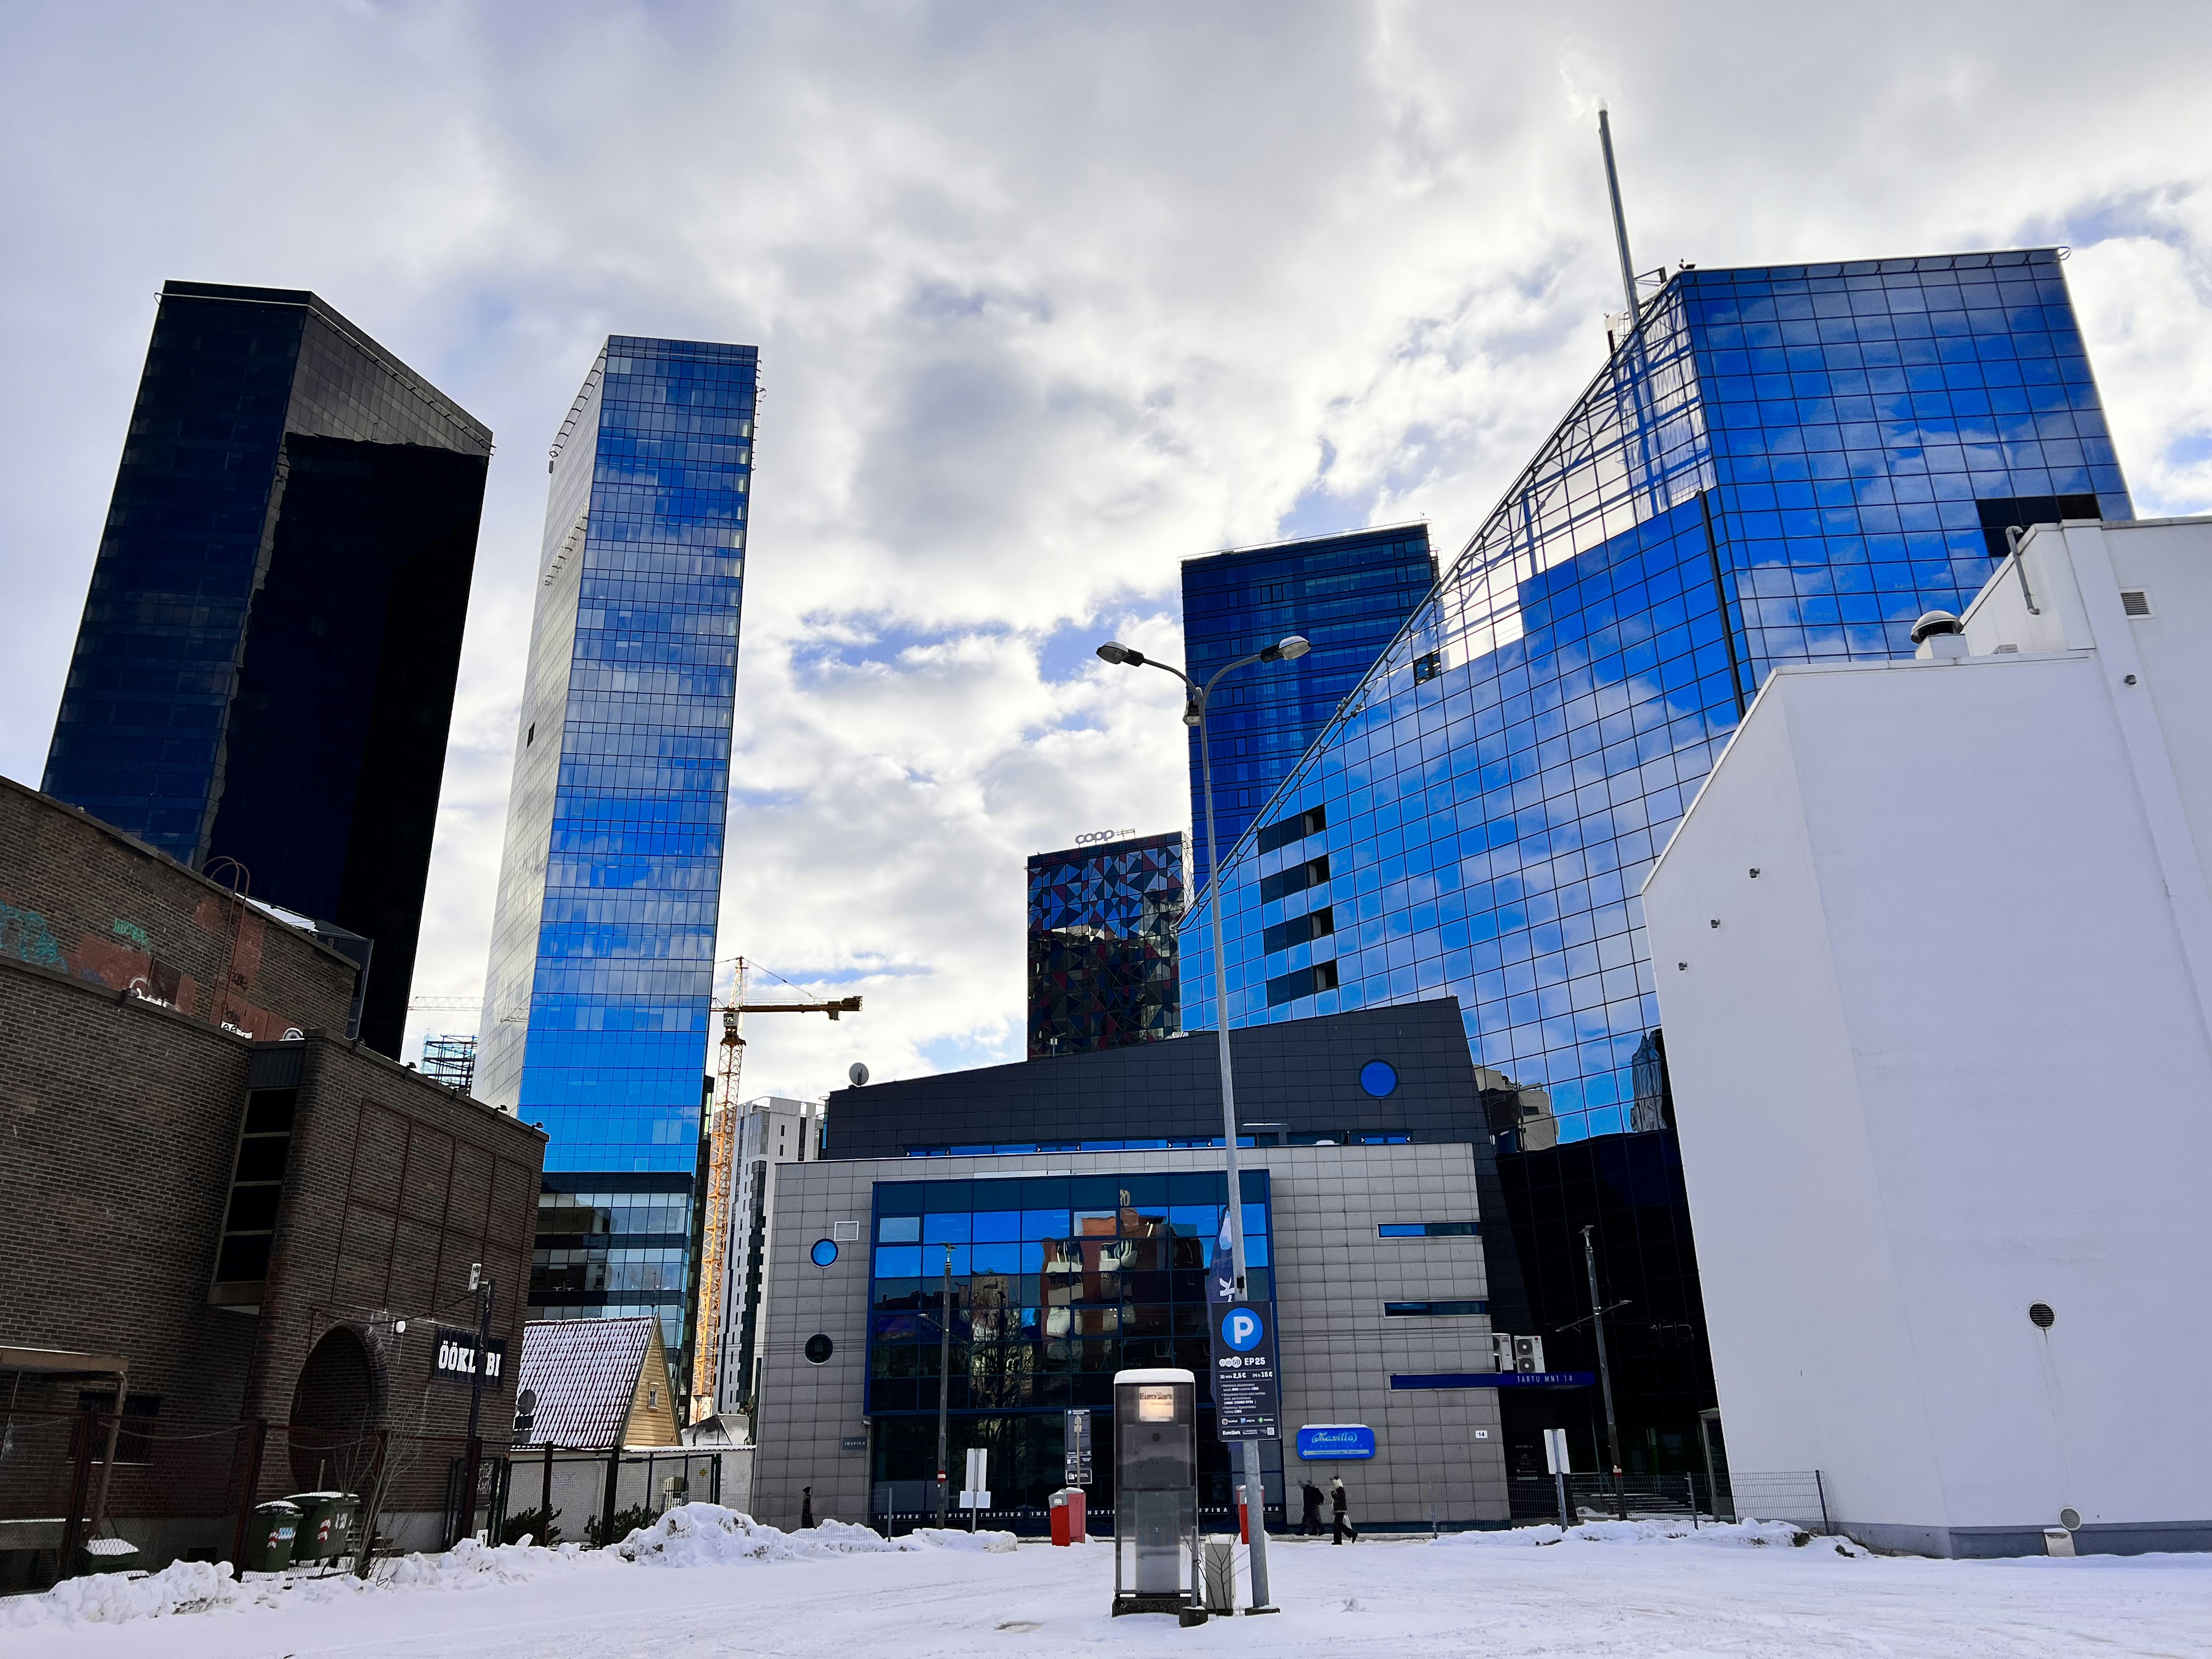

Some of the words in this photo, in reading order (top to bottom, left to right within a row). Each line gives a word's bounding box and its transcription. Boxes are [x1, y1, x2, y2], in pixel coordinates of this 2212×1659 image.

[1075, 830, 1114, 843] coop
[1233, 1316, 1254, 1344] P
[438, 1340, 501, 1376] ÖÖKLBI
[1244, 1357, 1266, 1365] EP25
